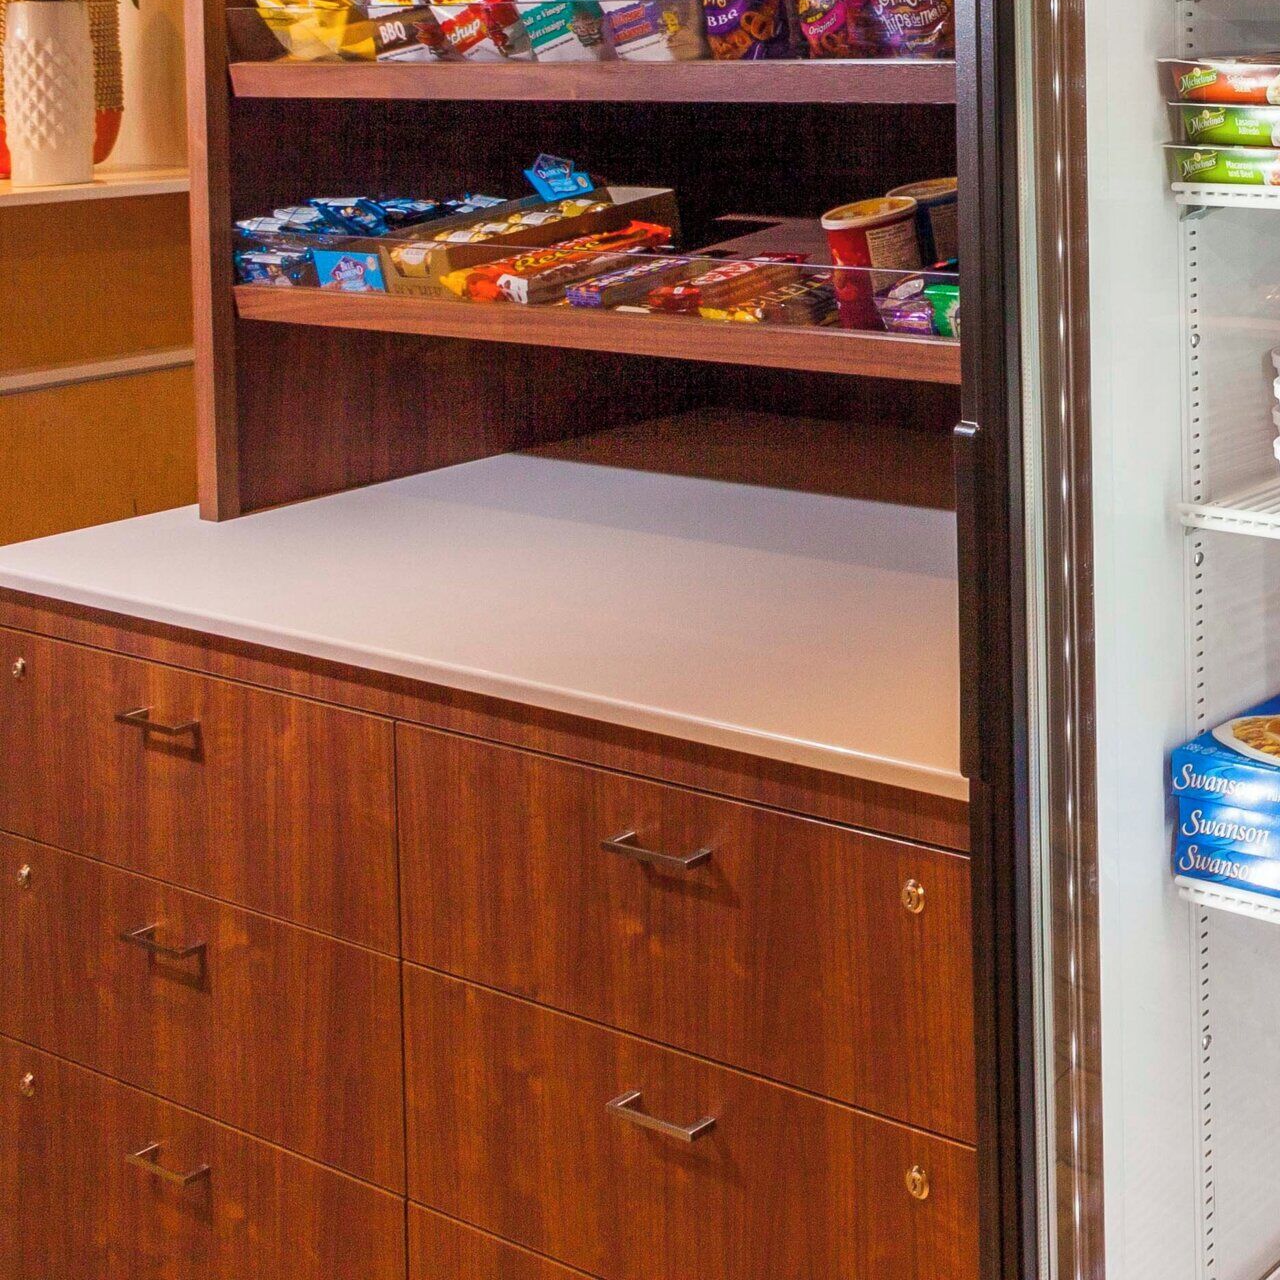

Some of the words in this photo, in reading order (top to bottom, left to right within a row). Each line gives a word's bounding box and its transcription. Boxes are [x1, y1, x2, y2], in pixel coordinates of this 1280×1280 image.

[707, 11, 739, 27] BBQ
[808, 15, 837, 35] Original
[379, 22, 407, 44] BBQ
[1182, 809, 1270, 846] Swanson
